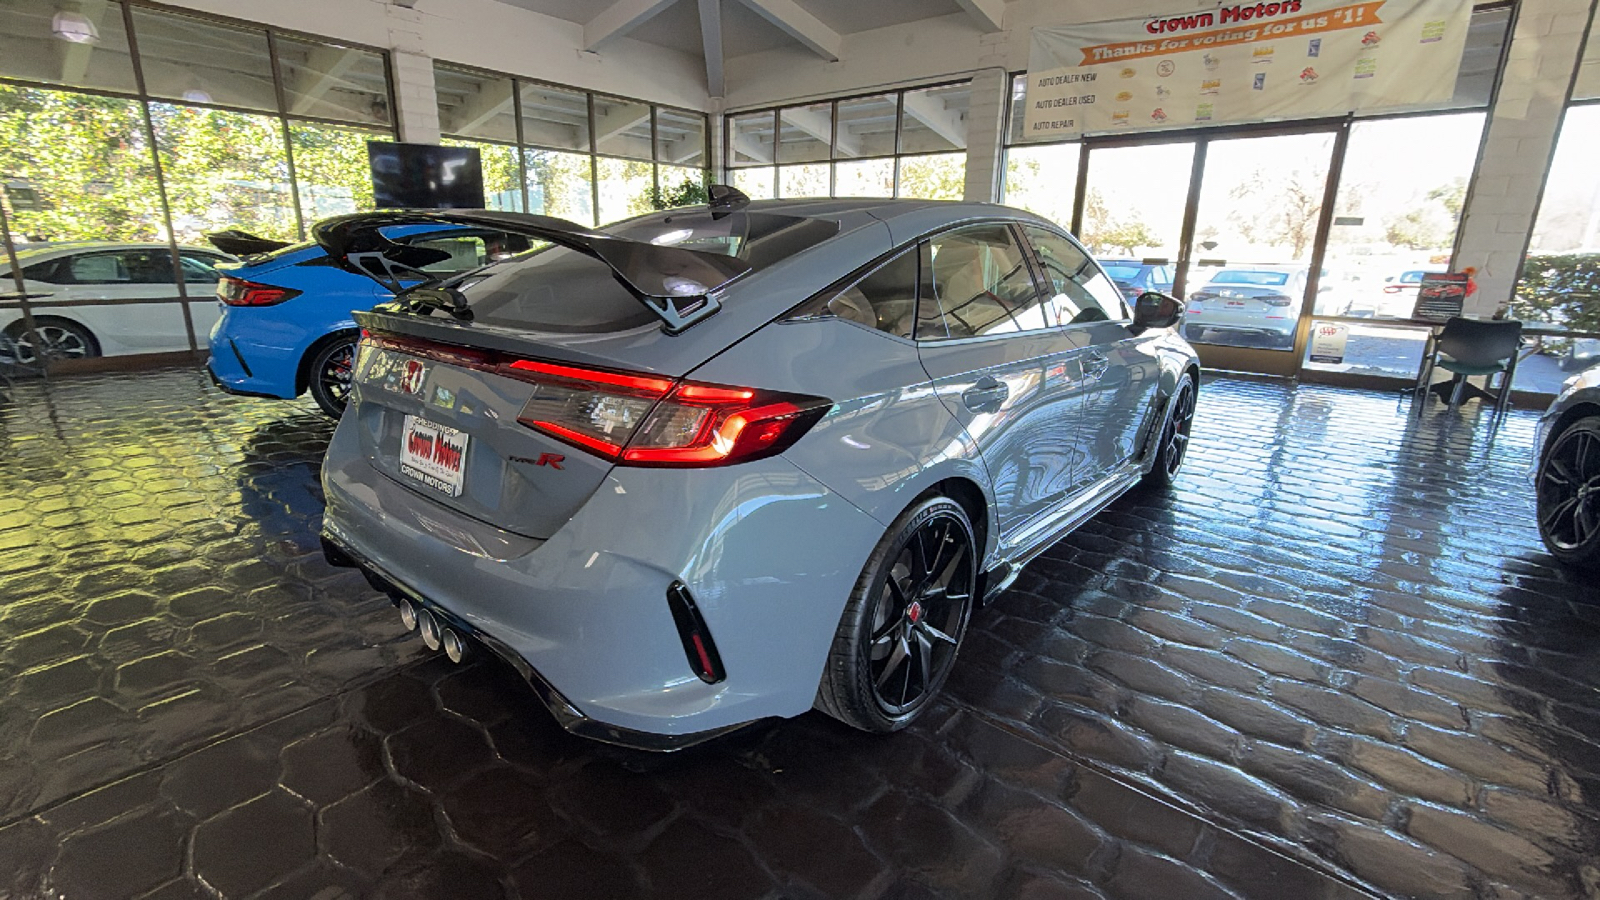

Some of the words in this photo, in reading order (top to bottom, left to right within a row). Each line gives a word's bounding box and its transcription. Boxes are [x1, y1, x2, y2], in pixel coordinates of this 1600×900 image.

[1145, 12, 1214, 34] Crown
[1219, 0, 1302, 24] Motors
[1092, 42, 1156, 61] Thanks
[1159, 39, 1189, 51] for
[1192, 29, 1259, 46] voting
[1262, 21, 1297, 36] for
[1301, 15, 1329, 29] us
[1333, 7, 1365, 24] #1!
[1038, 77, 1054, 87] AUTO
[1055, 74, 1080, 86] DEALER
[1080, 72, 1097, 82] NEW
[1035, 99, 1053, 109] AUTO
[1053, 96, 1078, 107] DEALER
[1078, 94, 1096, 105] USED
[1033, 121, 1050, 131] AUTO
[1051, 119, 1074, 129] REPAIR
[401, 464, 424, 482] CROWN
[424, 474, 454, 494] MOTORS
